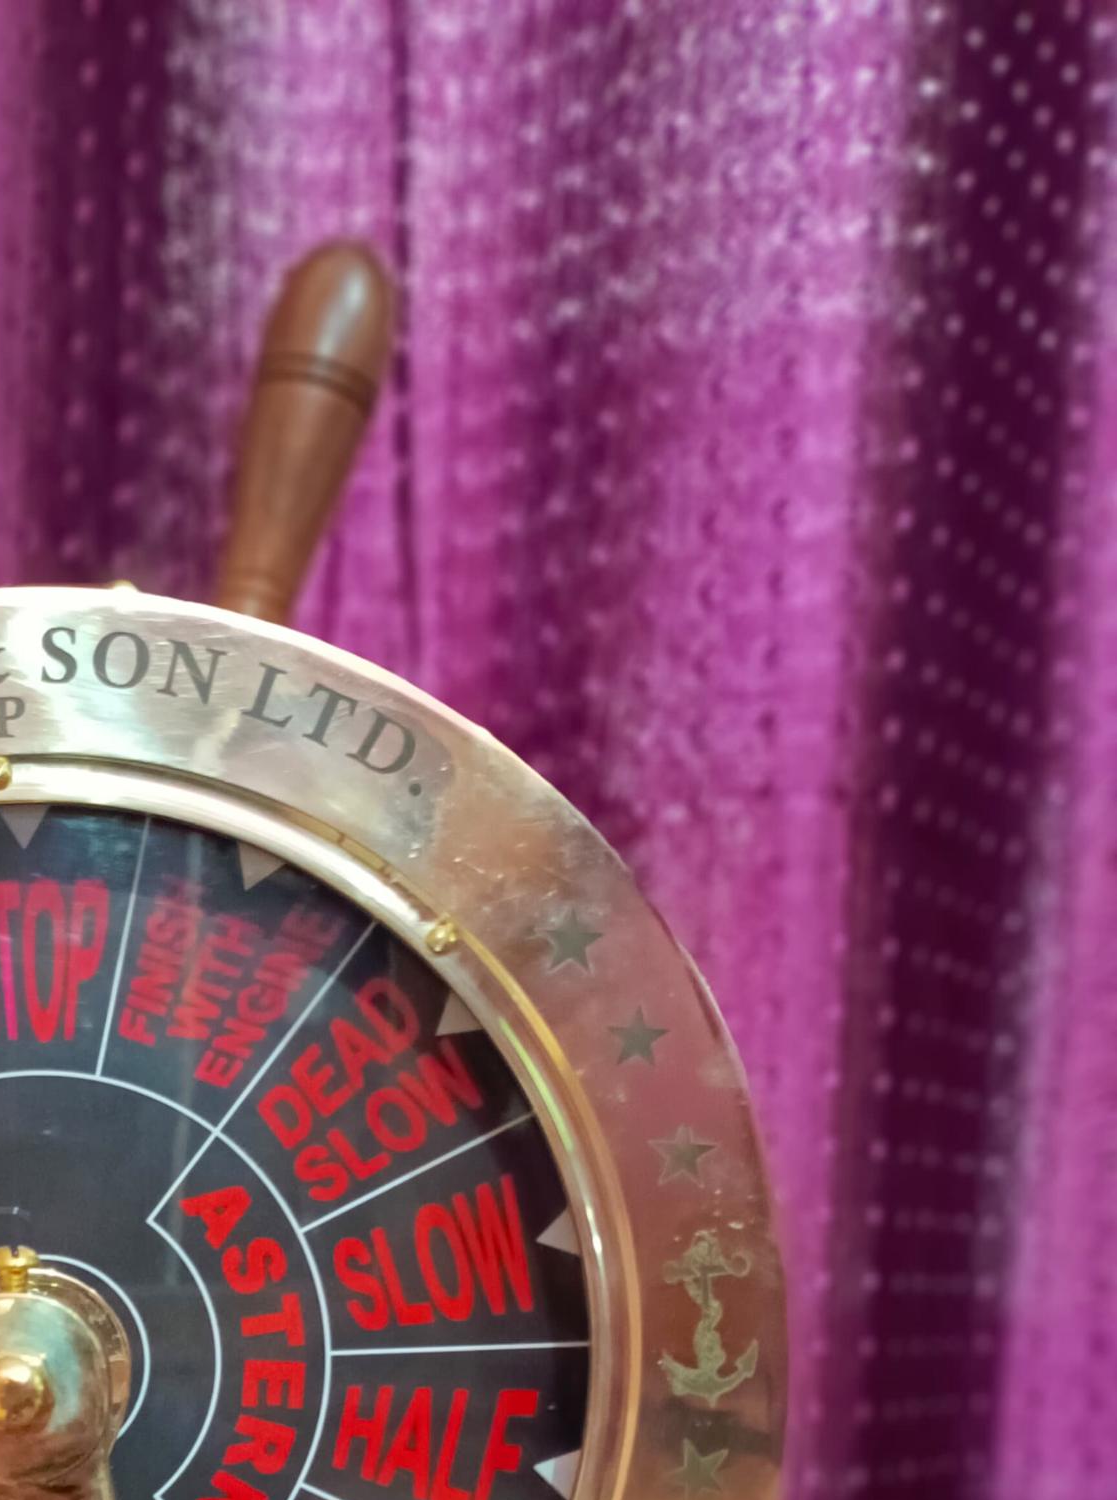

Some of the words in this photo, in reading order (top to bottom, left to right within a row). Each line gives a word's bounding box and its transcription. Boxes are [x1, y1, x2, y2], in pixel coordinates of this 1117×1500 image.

[41, 627, 226, 704] SON
[243, 661, 422, 797] LTD.
[167, 912, 264, 1042] WITH
[256, 977, 420, 1150] DEAD
[294, 1037, 481, 1202] SLOW
[333, 1174, 534, 1332] SLOW
